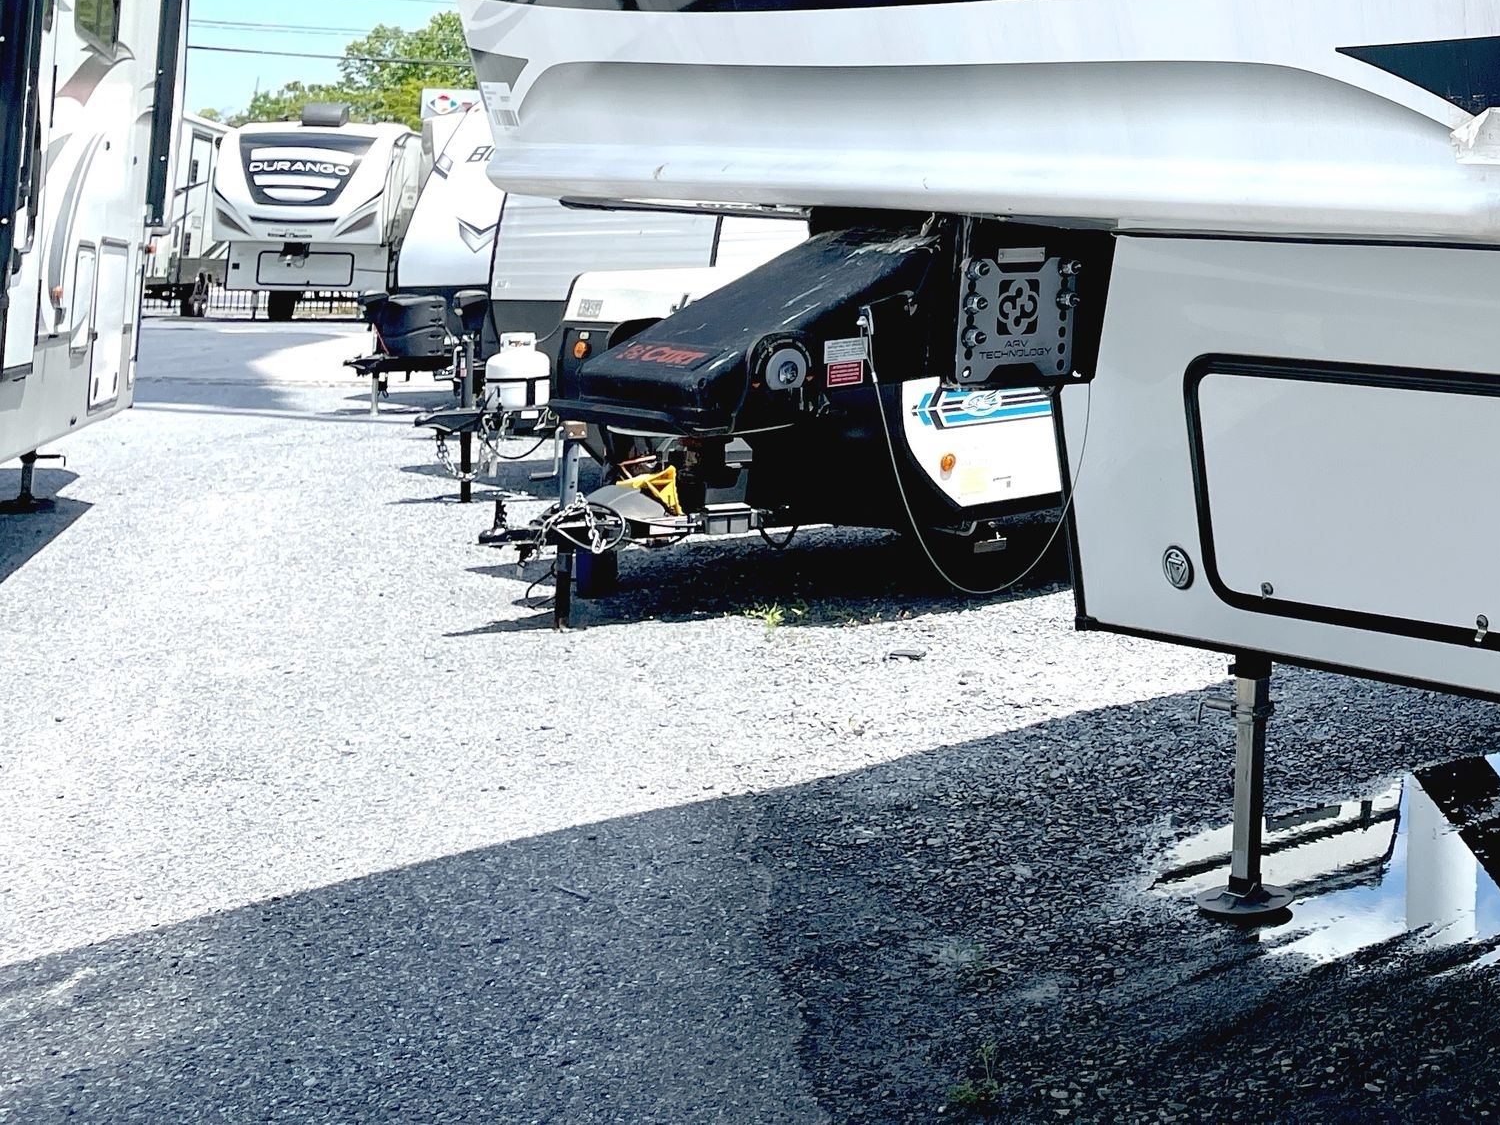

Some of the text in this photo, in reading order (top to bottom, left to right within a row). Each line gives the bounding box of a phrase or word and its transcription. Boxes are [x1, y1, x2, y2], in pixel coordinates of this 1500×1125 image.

[249, 161, 350, 176] DURANGO
[1004, 339, 1029, 349] ARV
[979, 347, 1052, 360] TECHNOLOGY
